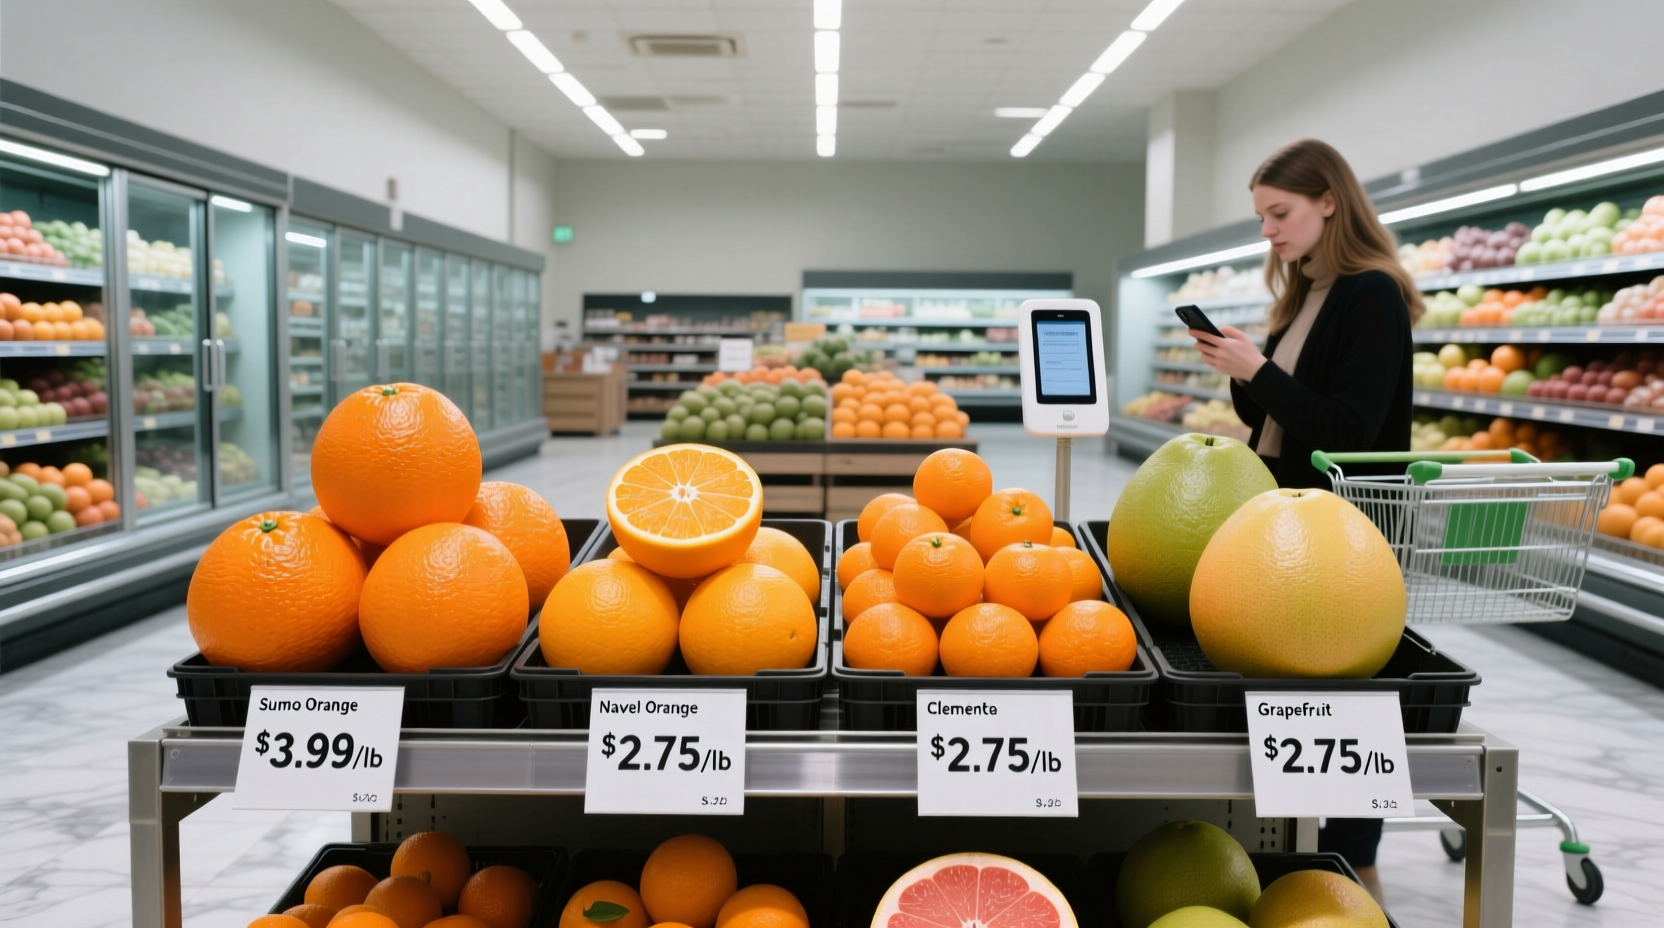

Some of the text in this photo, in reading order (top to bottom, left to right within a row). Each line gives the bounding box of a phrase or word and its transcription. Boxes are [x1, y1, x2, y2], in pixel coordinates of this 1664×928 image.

[258, 697, 359, 716] Sumo Orange
[599, 700, 699, 719] Navel Orange
[254, 728, 383, 770] $3.99/lb
[601, 731, 732, 774] $2.75/lb
[930, 733, 1062, 775] $2.75/lb
[1263, 733, 1395, 776] $2.75/lb
